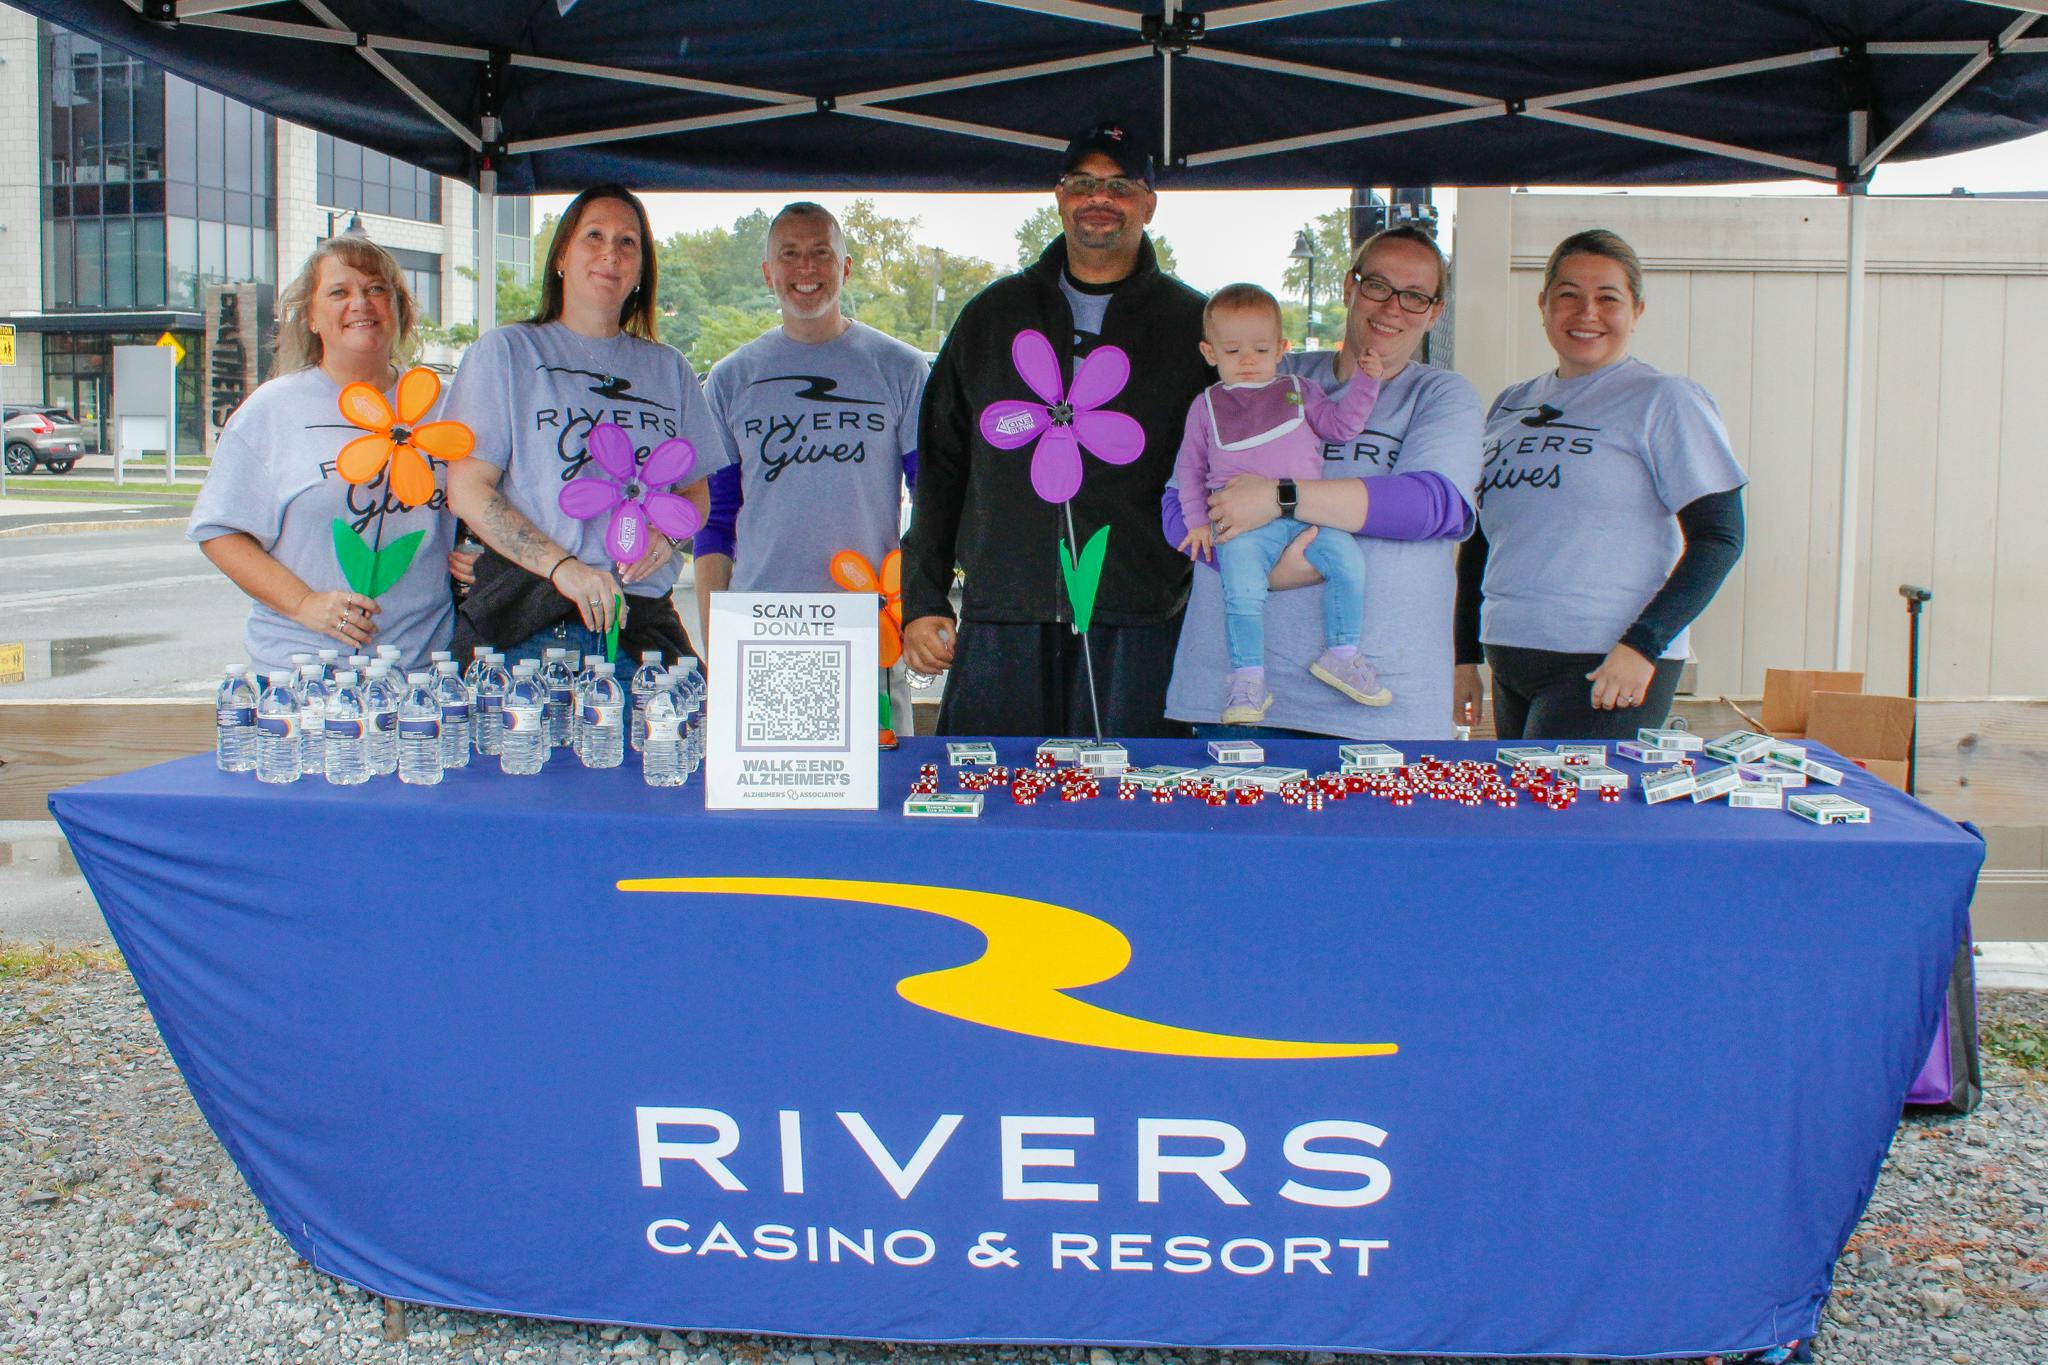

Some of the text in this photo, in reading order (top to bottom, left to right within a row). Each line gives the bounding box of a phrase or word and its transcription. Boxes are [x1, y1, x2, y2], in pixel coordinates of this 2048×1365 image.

[536, 407, 677, 438] RIVERS
[745, 411, 885, 438] RIVERS
[761, 422, 865, 482] Gives
[1323, 443, 1399, 468] ERS
[752, 604, 836, 619] SCAN TO
[754, 622, 835, 637] DONATE
[743, 759, 794, 772] WALK
[808, 759, 845, 772] END
[736, 773, 850, 786] ALZHEIMER'S
[635, 1106, 1392, 1208] RIVERS
[646, 1219, 1389, 1277] CASINO & RESORT
